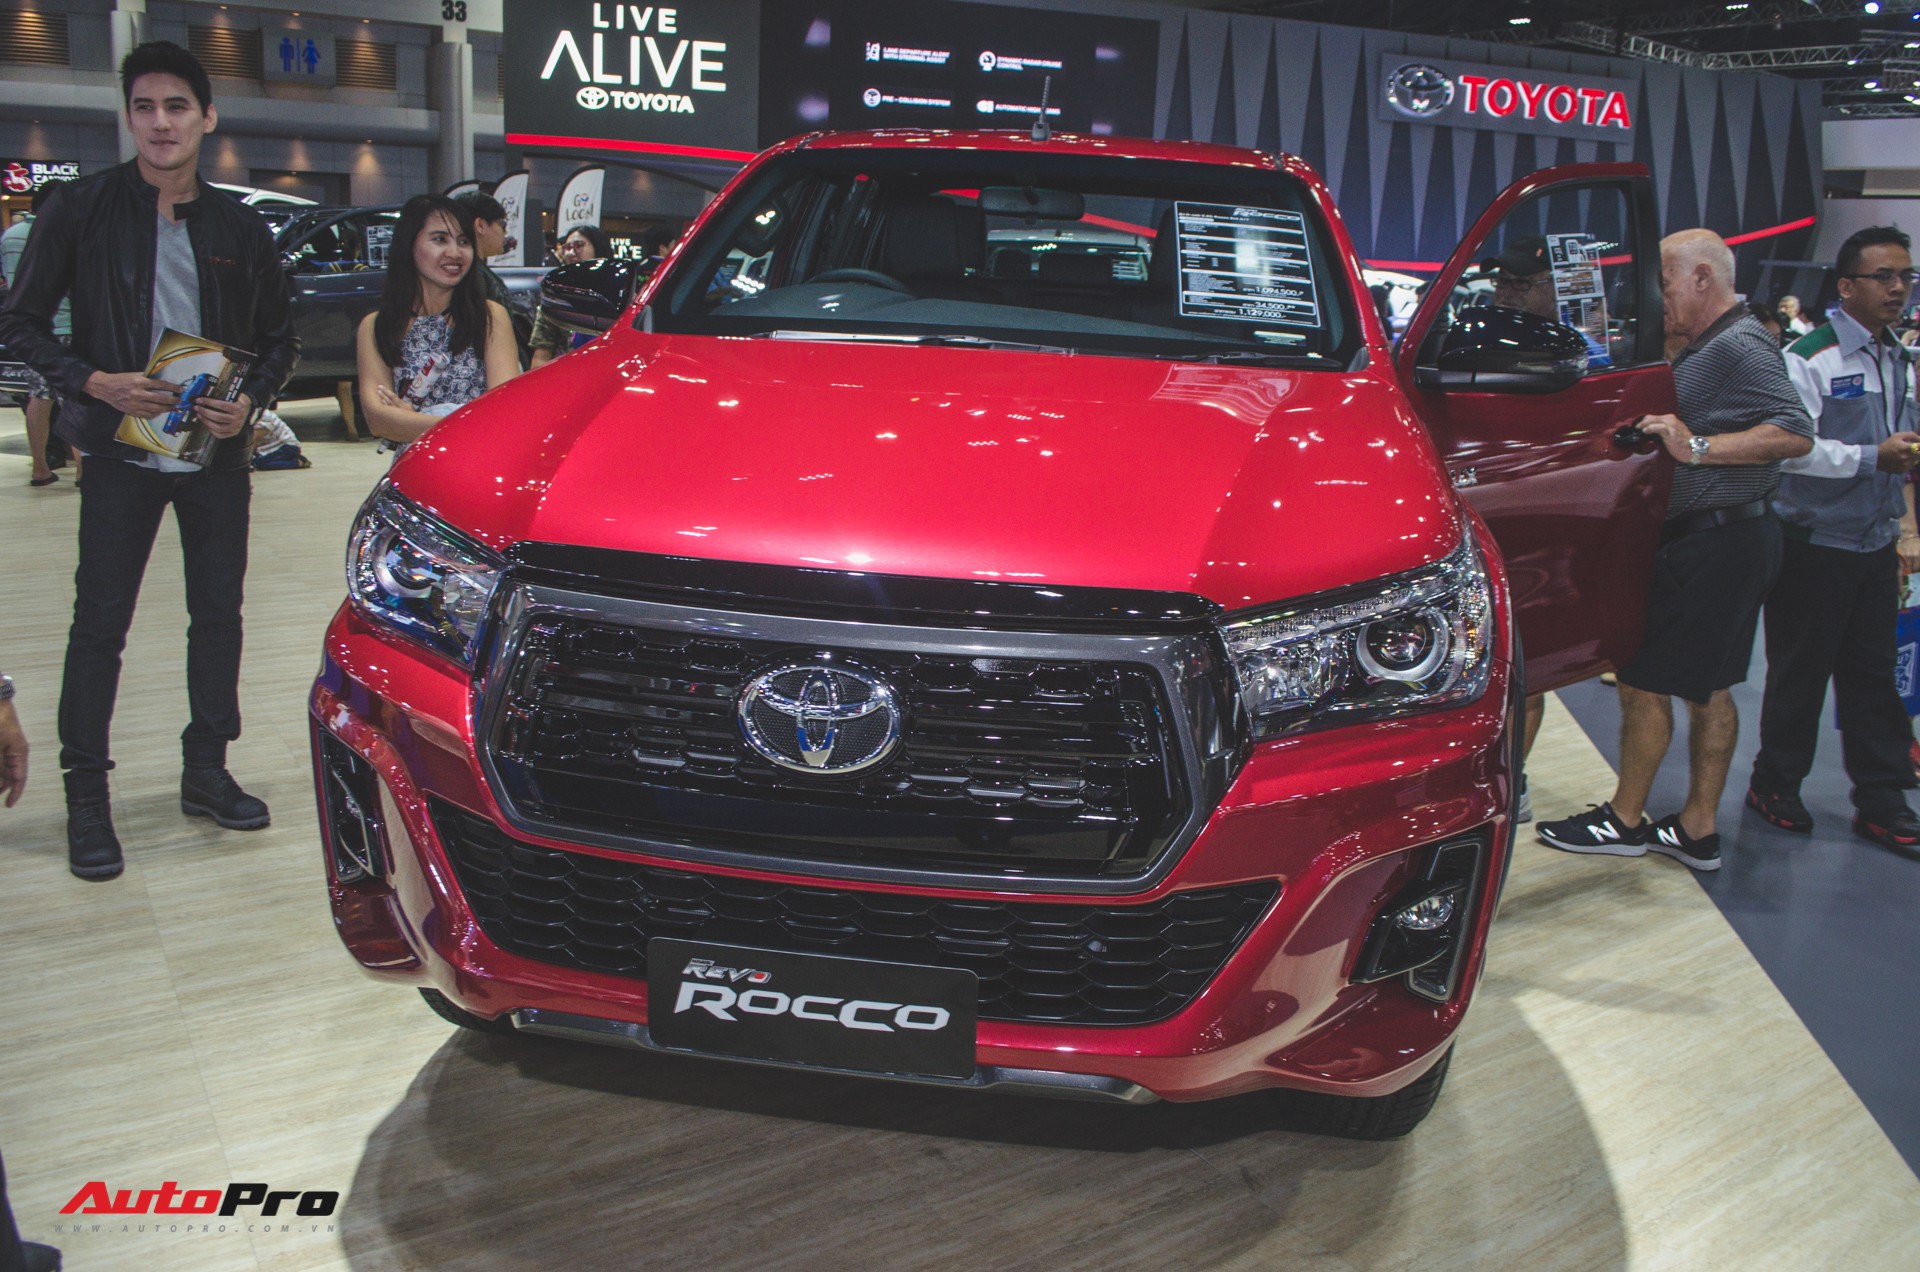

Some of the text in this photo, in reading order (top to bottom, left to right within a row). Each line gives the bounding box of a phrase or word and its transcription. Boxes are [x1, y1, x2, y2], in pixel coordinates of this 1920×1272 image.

[441, 0, 467, 22] 33
[593, 3, 678, 34] LIVE
[540, 30, 727, 92] ALIVE
[610, 91, 695, 114] TOYOTA
[1459, 75, 1632, 129] TOYOTA
[32, 163, 79, 176] BLACK
[610, 237, 631, 246] LIVE
[673, 981, 950, 1032] ROCCO
